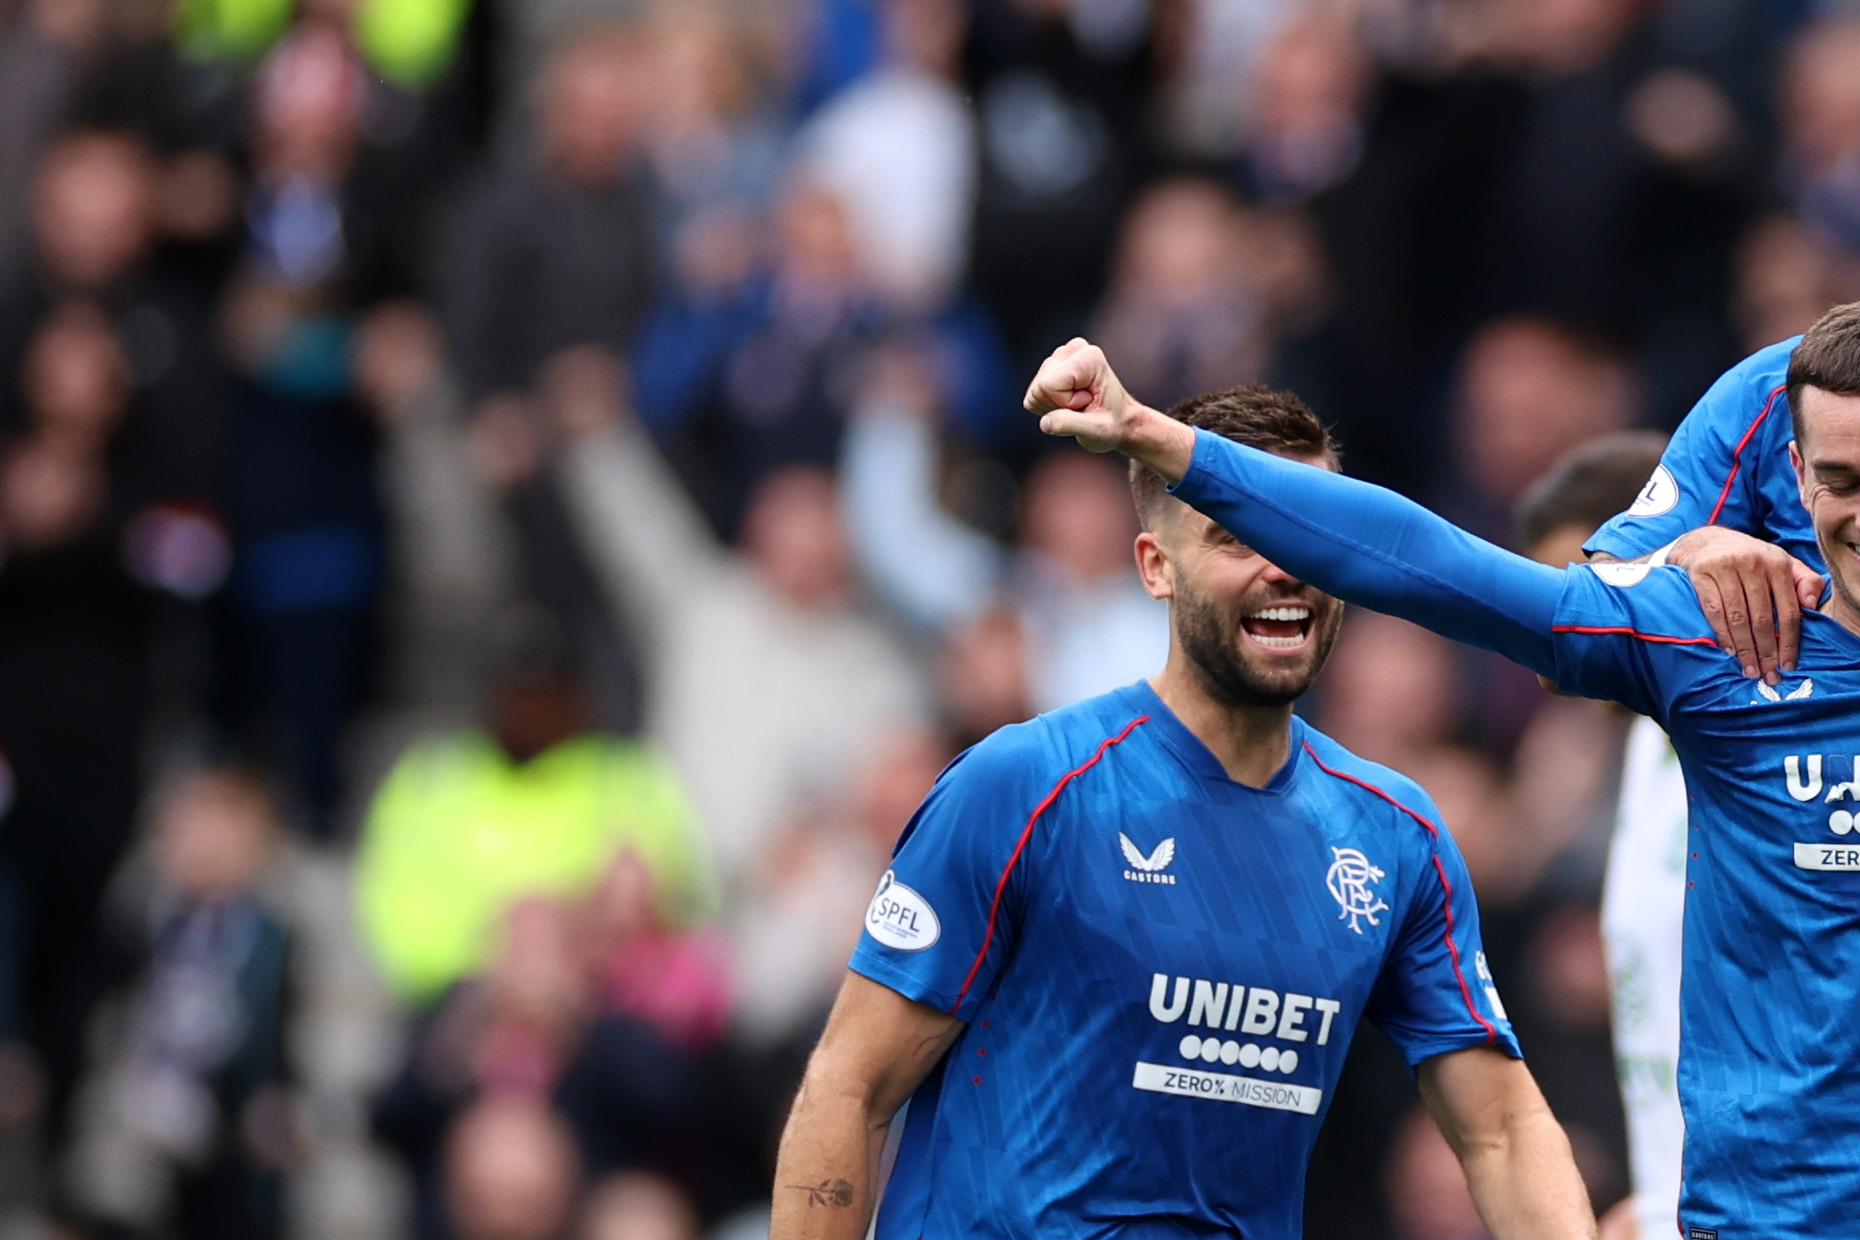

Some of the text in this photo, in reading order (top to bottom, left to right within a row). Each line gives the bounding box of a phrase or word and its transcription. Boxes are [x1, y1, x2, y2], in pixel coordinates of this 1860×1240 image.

[1123, 869, 1176, 885] CASTORE
[878, 897, 920, 933] SPFL
[1150, 972, 1341, 1046] UNIBET
[1164, 1071, 1302, 1108] ZERO% MISSION
